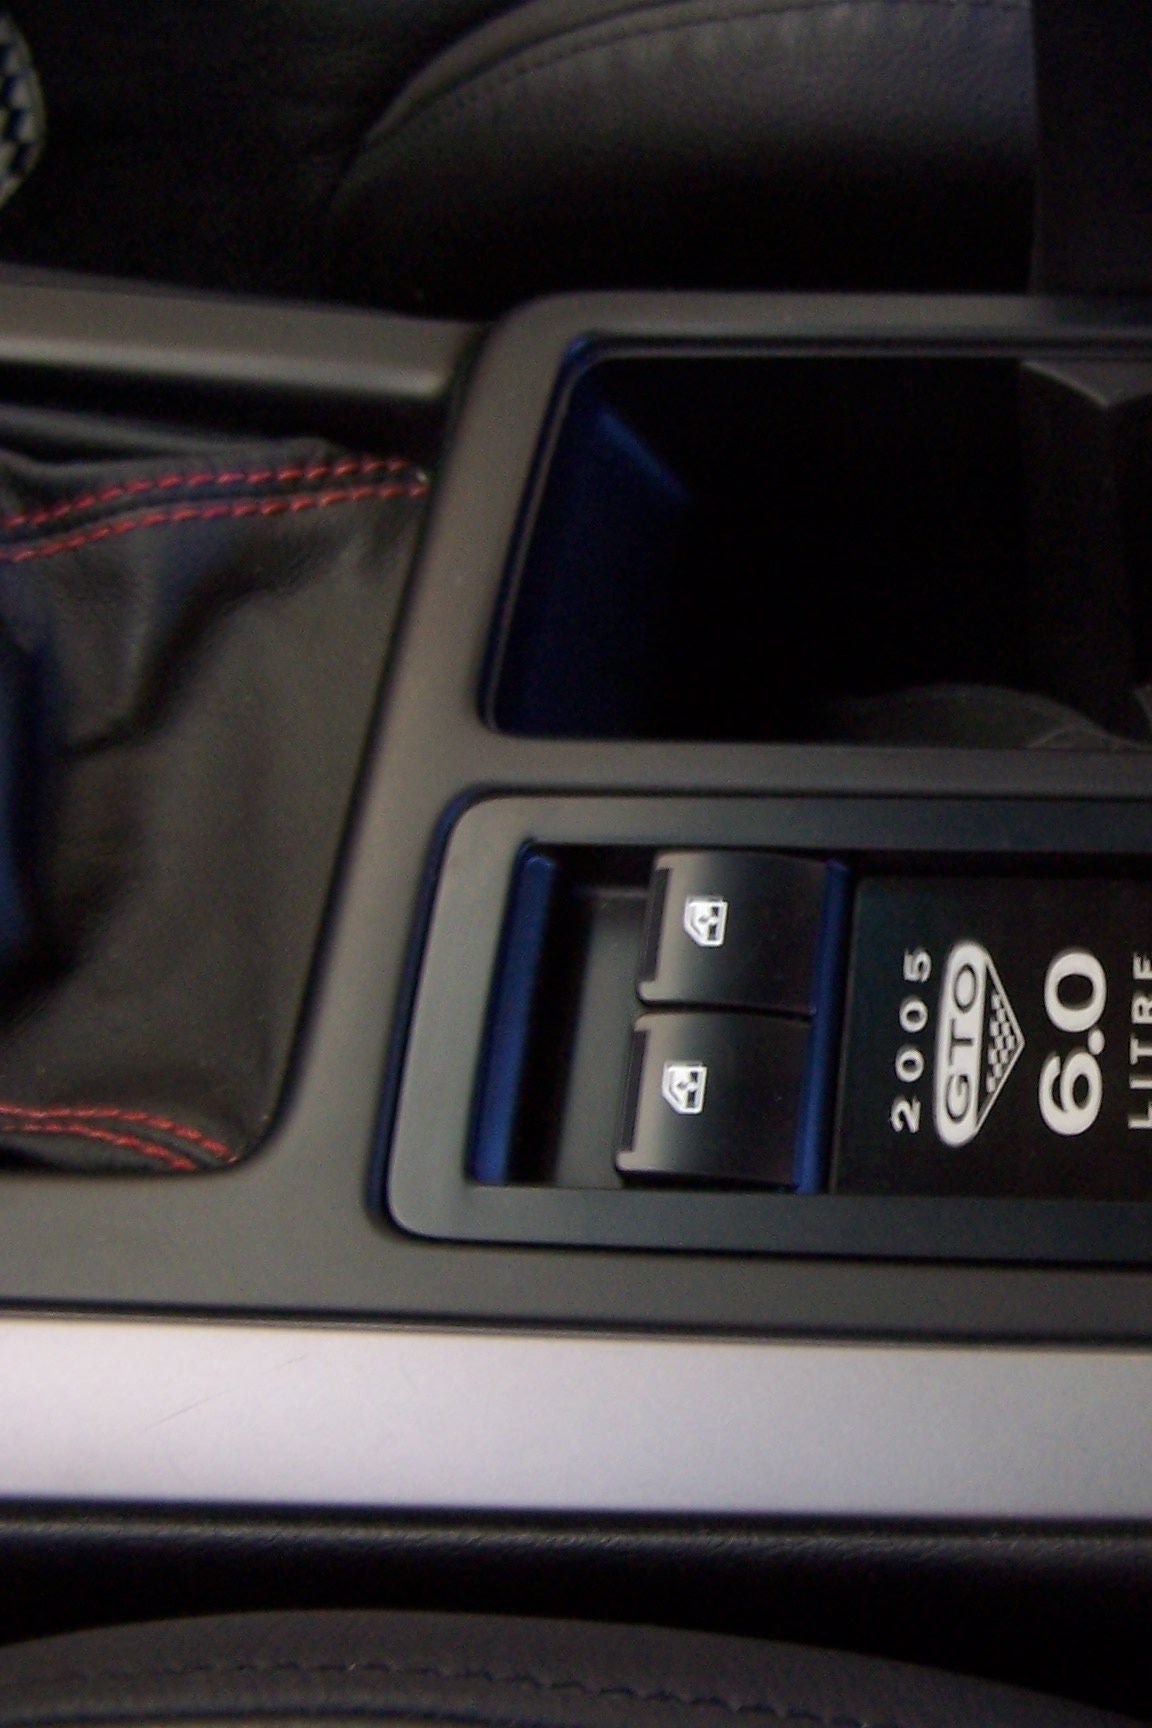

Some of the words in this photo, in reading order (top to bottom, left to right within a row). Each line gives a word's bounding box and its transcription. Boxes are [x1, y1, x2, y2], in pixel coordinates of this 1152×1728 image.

[890, 950, 932, 1133] 2005
[943, 962, 979, 1123] GTO
[1038, 951, 1107, 1135] 6.0
